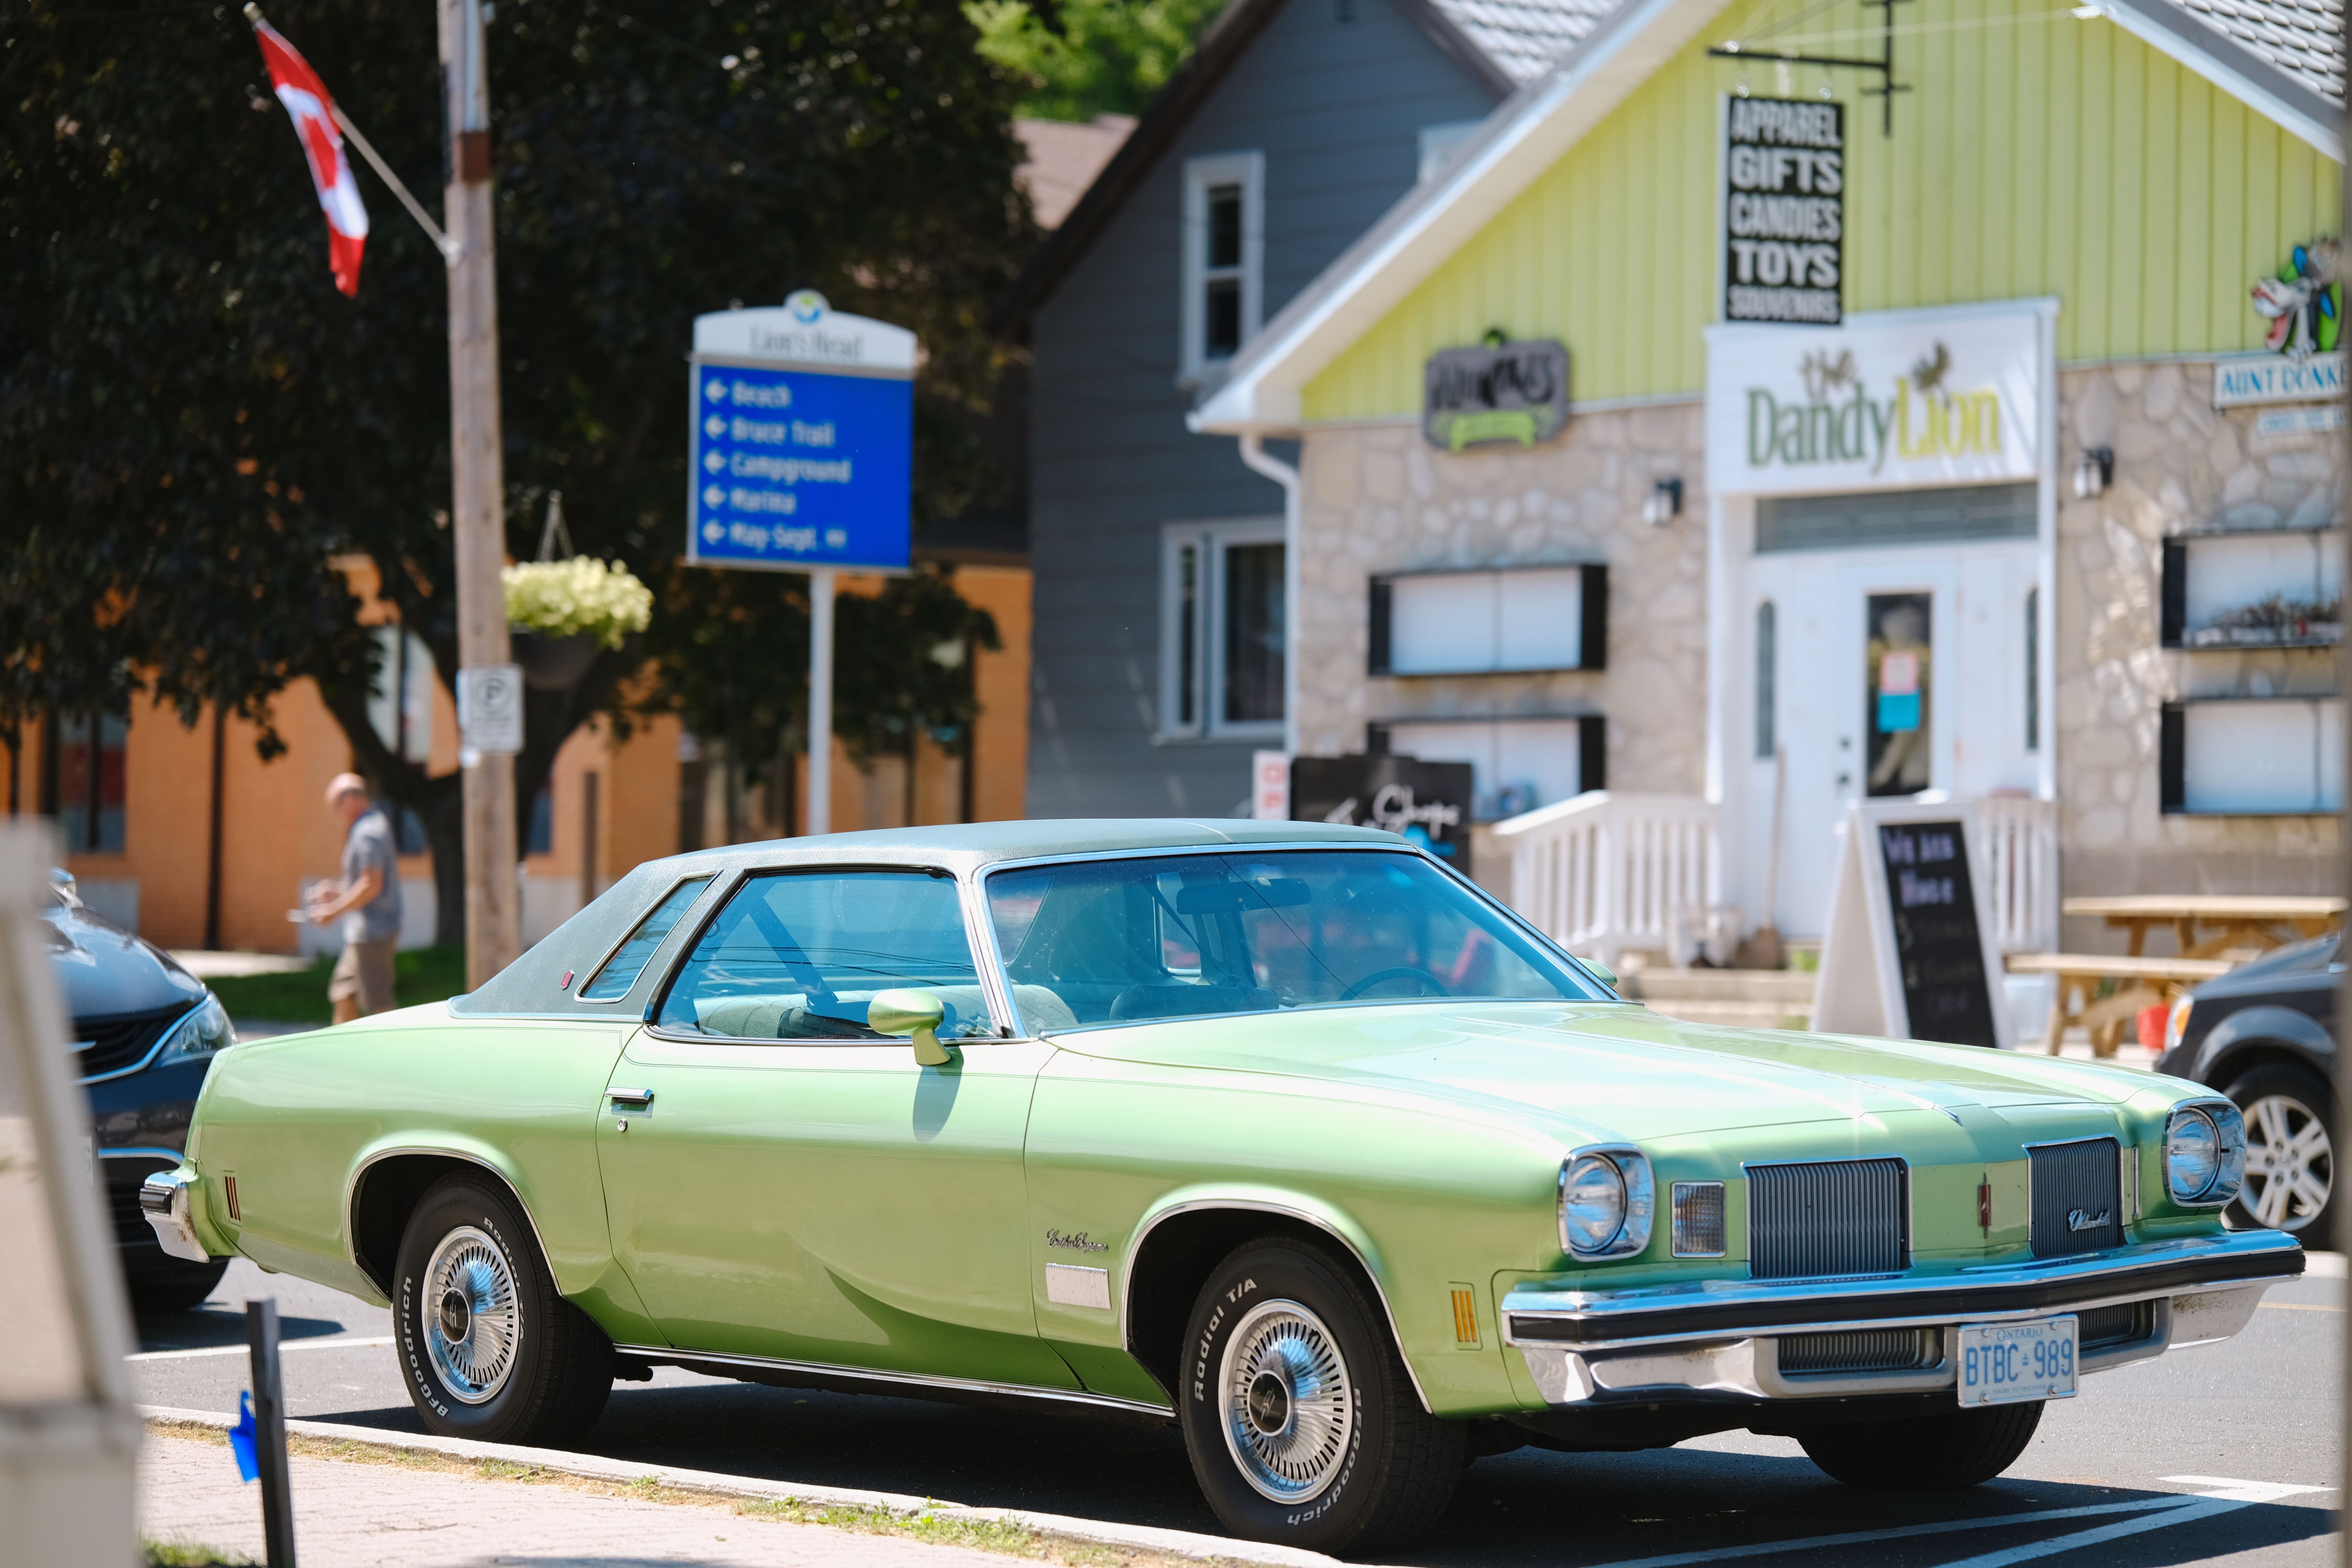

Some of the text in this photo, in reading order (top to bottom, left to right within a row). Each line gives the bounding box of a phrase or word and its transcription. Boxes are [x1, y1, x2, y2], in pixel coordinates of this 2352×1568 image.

[1731, 98, 1842, 147] APPAREL
[1730, 144, 1842, 194] GIFTS
[1730, 191, 1841, 242] CANDIES
[1730, 239, 1839, 289] TOYS
[732, 382, 790, 407] Beach
[2223, 366, 2274, 394] AUNT
[732, 418, 834, 446] Bruce Trail
[732, 454, 851, 484] Campground
[730, 488, 796, 514] Marina
[483, 1216, 521, 1288] Radial
[401, 1276, 449, 1418] BFGoodrich
[1193, 1278, 1257, 1402] Radial T/A
[1997, 1327, 2043, 1342] ONTARIO
[1966, 1338, 2073, 1386] BTBC 989
[1287, 1387, 1362, 1526] BFGoodrich
